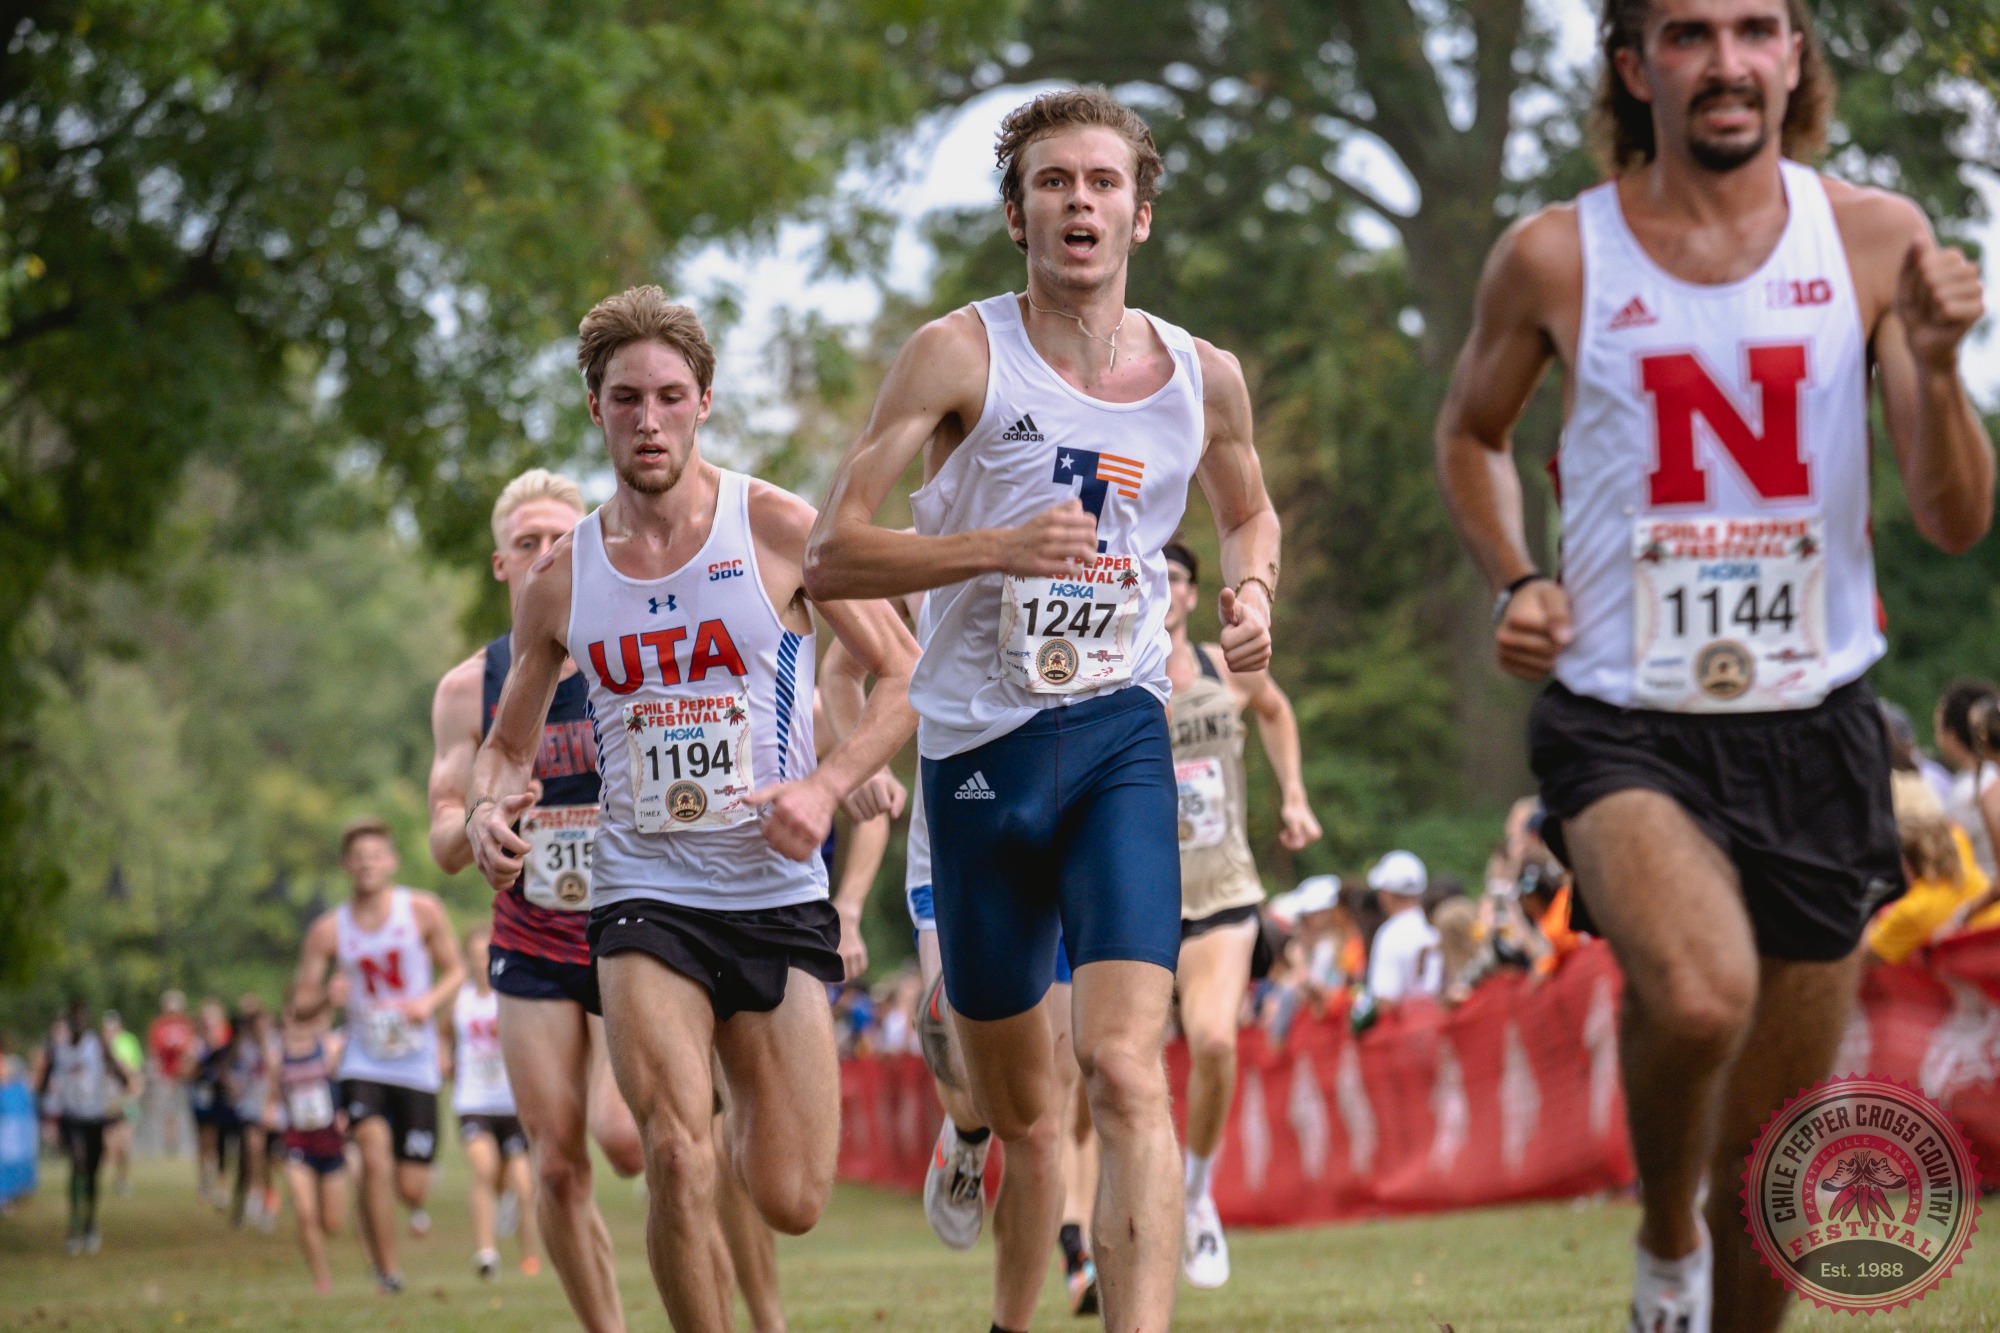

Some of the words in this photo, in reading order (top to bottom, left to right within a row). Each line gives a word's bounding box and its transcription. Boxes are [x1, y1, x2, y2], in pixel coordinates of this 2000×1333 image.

[1638, 342, 1814, 509] N
[1002, 431, 1044, 442] adidas
[1049, 583, 1094, 599] HOKA
[1022, 598, 1117, 638] 1247
[1664, 582, 1797, 637] 1144
[588, 618, 748, 695] UTA
[1006, 661, 1029, 675] TIMEX
[632, 702, 674, 717] CHILE
[679, 696, 735, 712] PEPPER
[648, 711, 721, 728] FESTIVAL
[664, 727, 705, 742] HOKA
[645, 739, 733, 781] 1194
[954, 789, 996, 800] adidas
[639, 810, 661, 818] TIMEX
[359, 950, 404, 995] N
